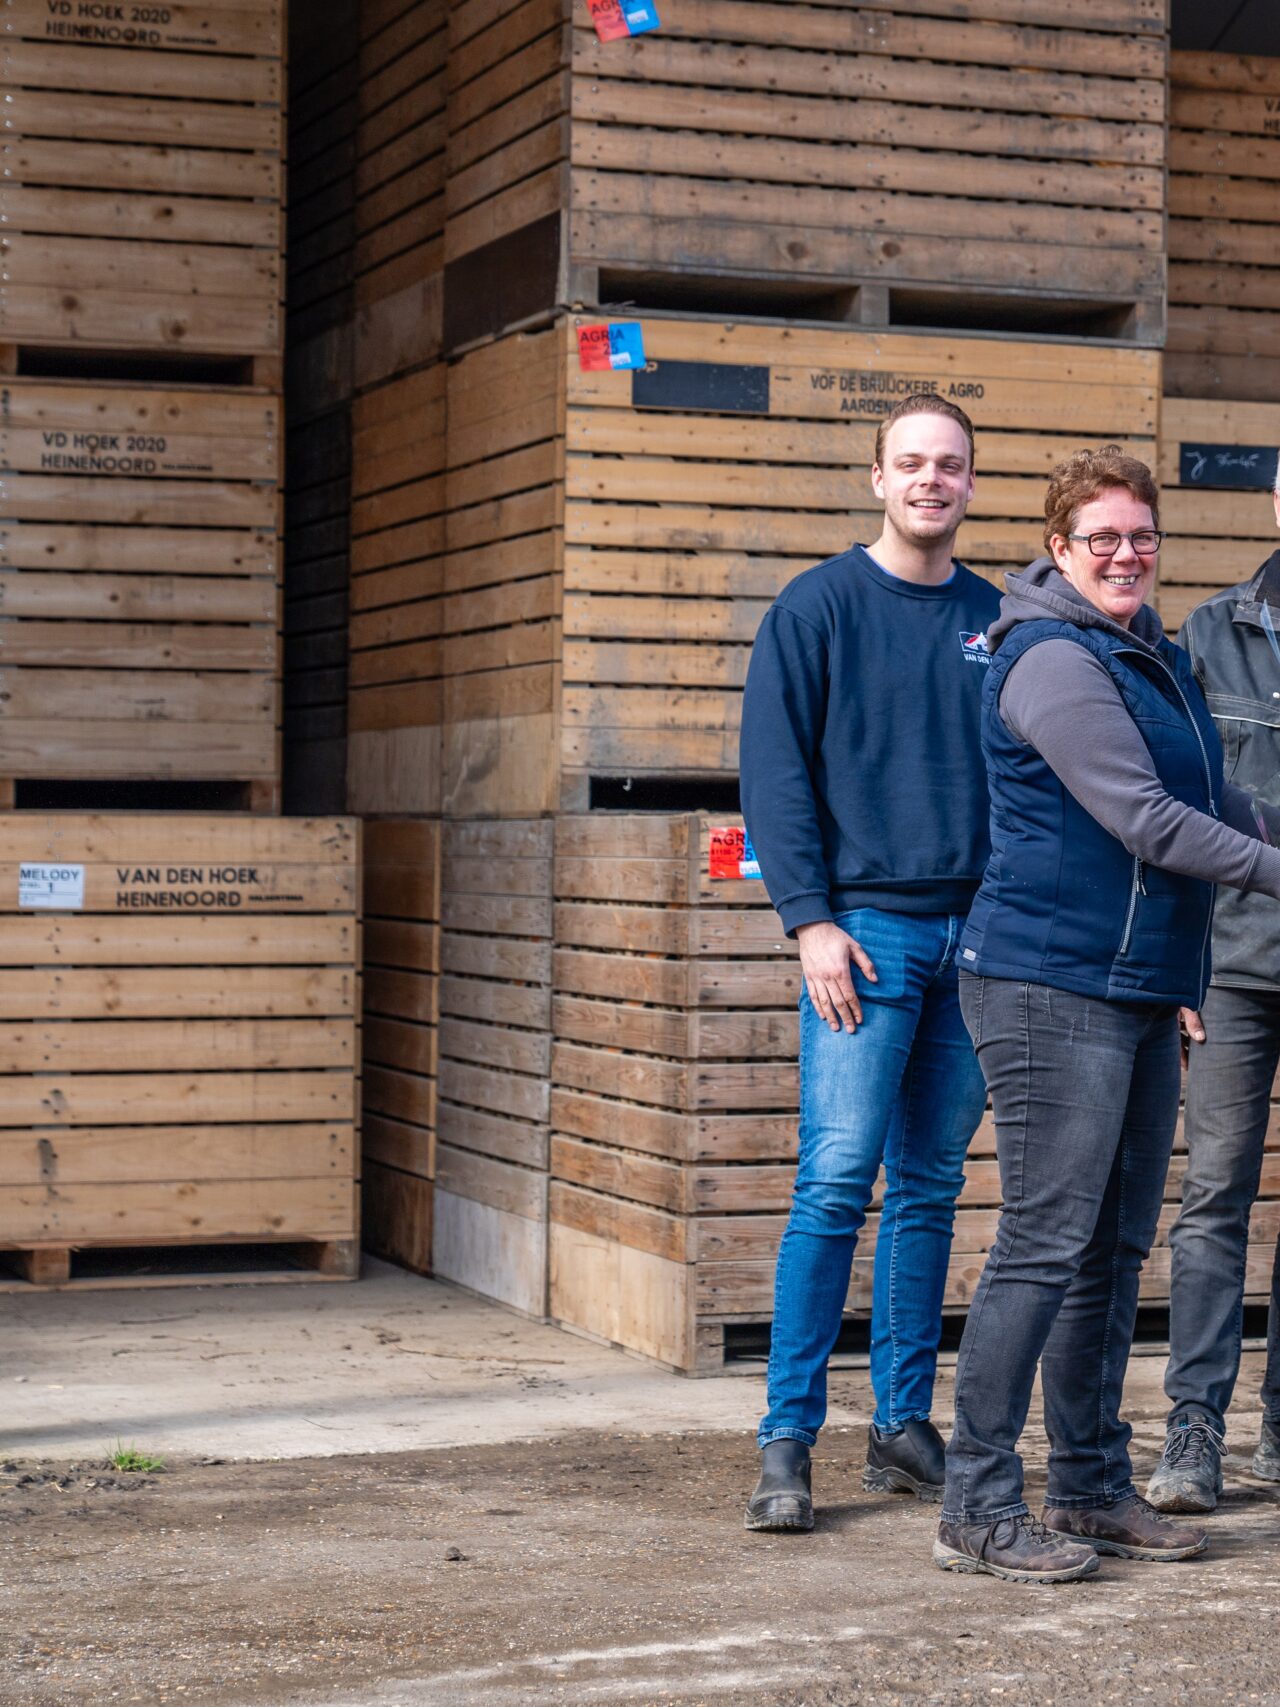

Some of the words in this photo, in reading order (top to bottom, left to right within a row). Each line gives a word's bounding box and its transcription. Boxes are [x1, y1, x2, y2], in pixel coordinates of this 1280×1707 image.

[47, 1, 72, 16] VD
[77, 5, 125, 21] HOEK
[131, 7, 172, 25] 2020
[46, 21, 161, 44] HEINENOORD
[580, 329, 625, 343] AGRIA
[811, 373, 836, 391] VOF
[839, 374, 856, 392] DE
[947, 382, 985, 399] AGRO
[42, 432, 68, 448] VD
[74, 434, 120, 451] HOEK
[127, 437, 167, 453] 2020
[41, 453, 157, 474] HEINENOORD
[964, 653, 977, 662] VAN
[736, 847, 753, 861] 25
[20, 867, 80, 882] MELODY
[117, 868, 160, 885] VAN
[166, 868, 203, 885] DEN
[209, 867, 258, 884] HOEK
[116, 891, 242, 908] HEINENOORD
